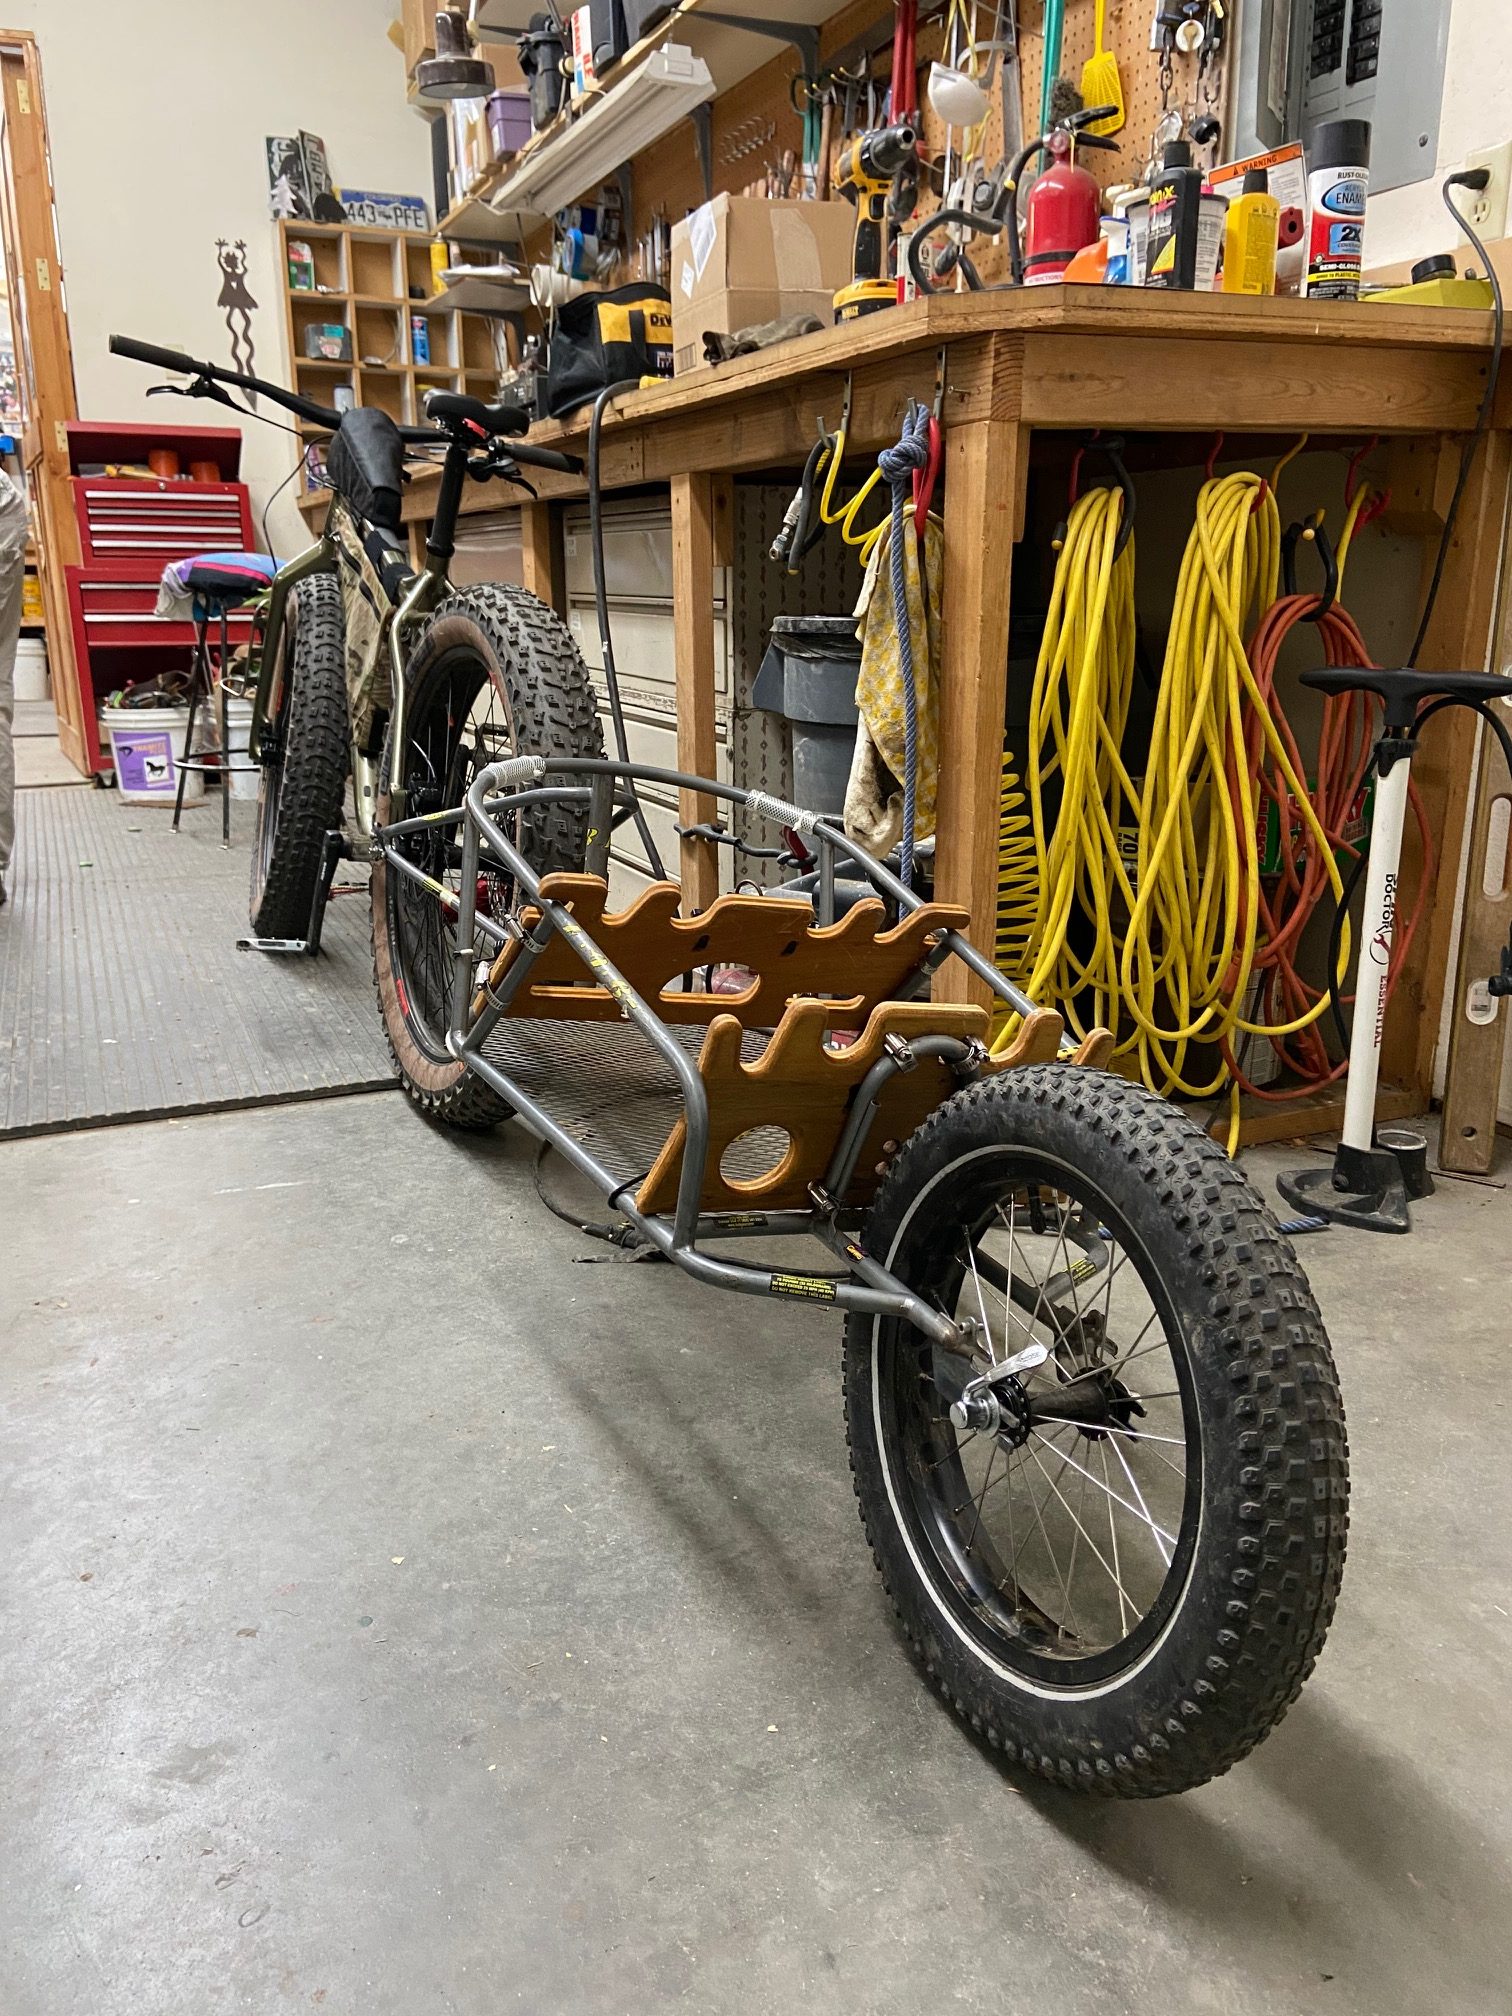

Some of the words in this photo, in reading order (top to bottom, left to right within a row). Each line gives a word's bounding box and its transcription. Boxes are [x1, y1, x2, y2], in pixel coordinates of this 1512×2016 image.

[1242, 155, 1278, 172] WARNING
[1340, 226, 1361, 242] 2X
[1122, 832, 1139, 854] 70
[1376, 874, 1394, 933] DOCTOR
[1374, 975, 1388, 1048] ESSENTIAL
